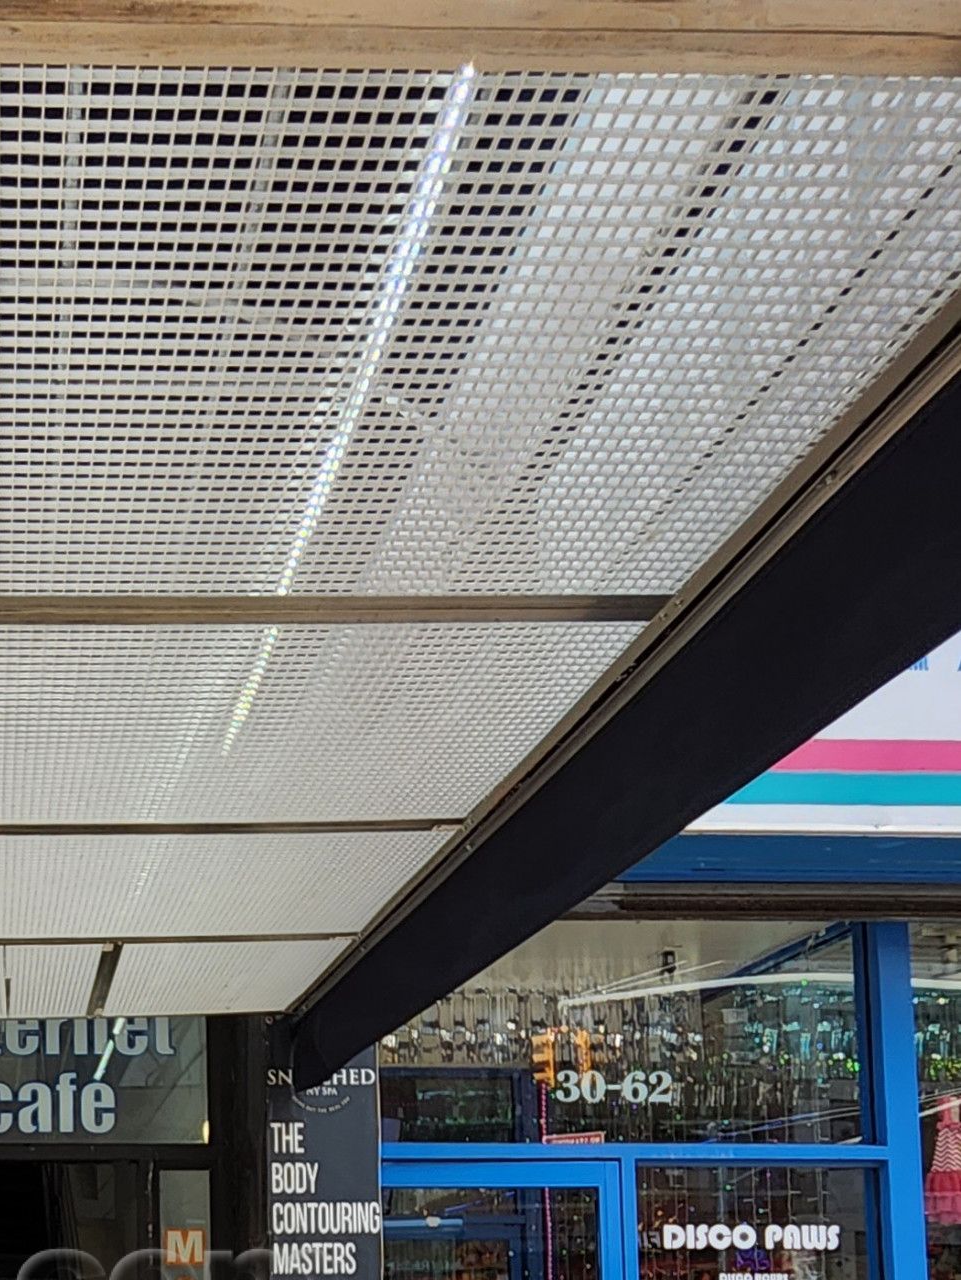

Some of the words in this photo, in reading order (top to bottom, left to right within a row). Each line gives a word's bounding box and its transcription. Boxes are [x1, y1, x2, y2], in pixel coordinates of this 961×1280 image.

[267, 1069, 376, 1086] SNHED
[322, 1087, 338, 1096] SPA
[556, 1070, 672, 1102] 30-62
[270, 1122, 305, 1154] THE
[271, 1162, 319, 1194] BODY
[272, 1202, 381, 1235] CONTOURING
[662, 1224, 757, 1250] DISCO
[764, 1224, 841, 1250] PAWS
[273, 1242, 357, 1275] MASTERS
